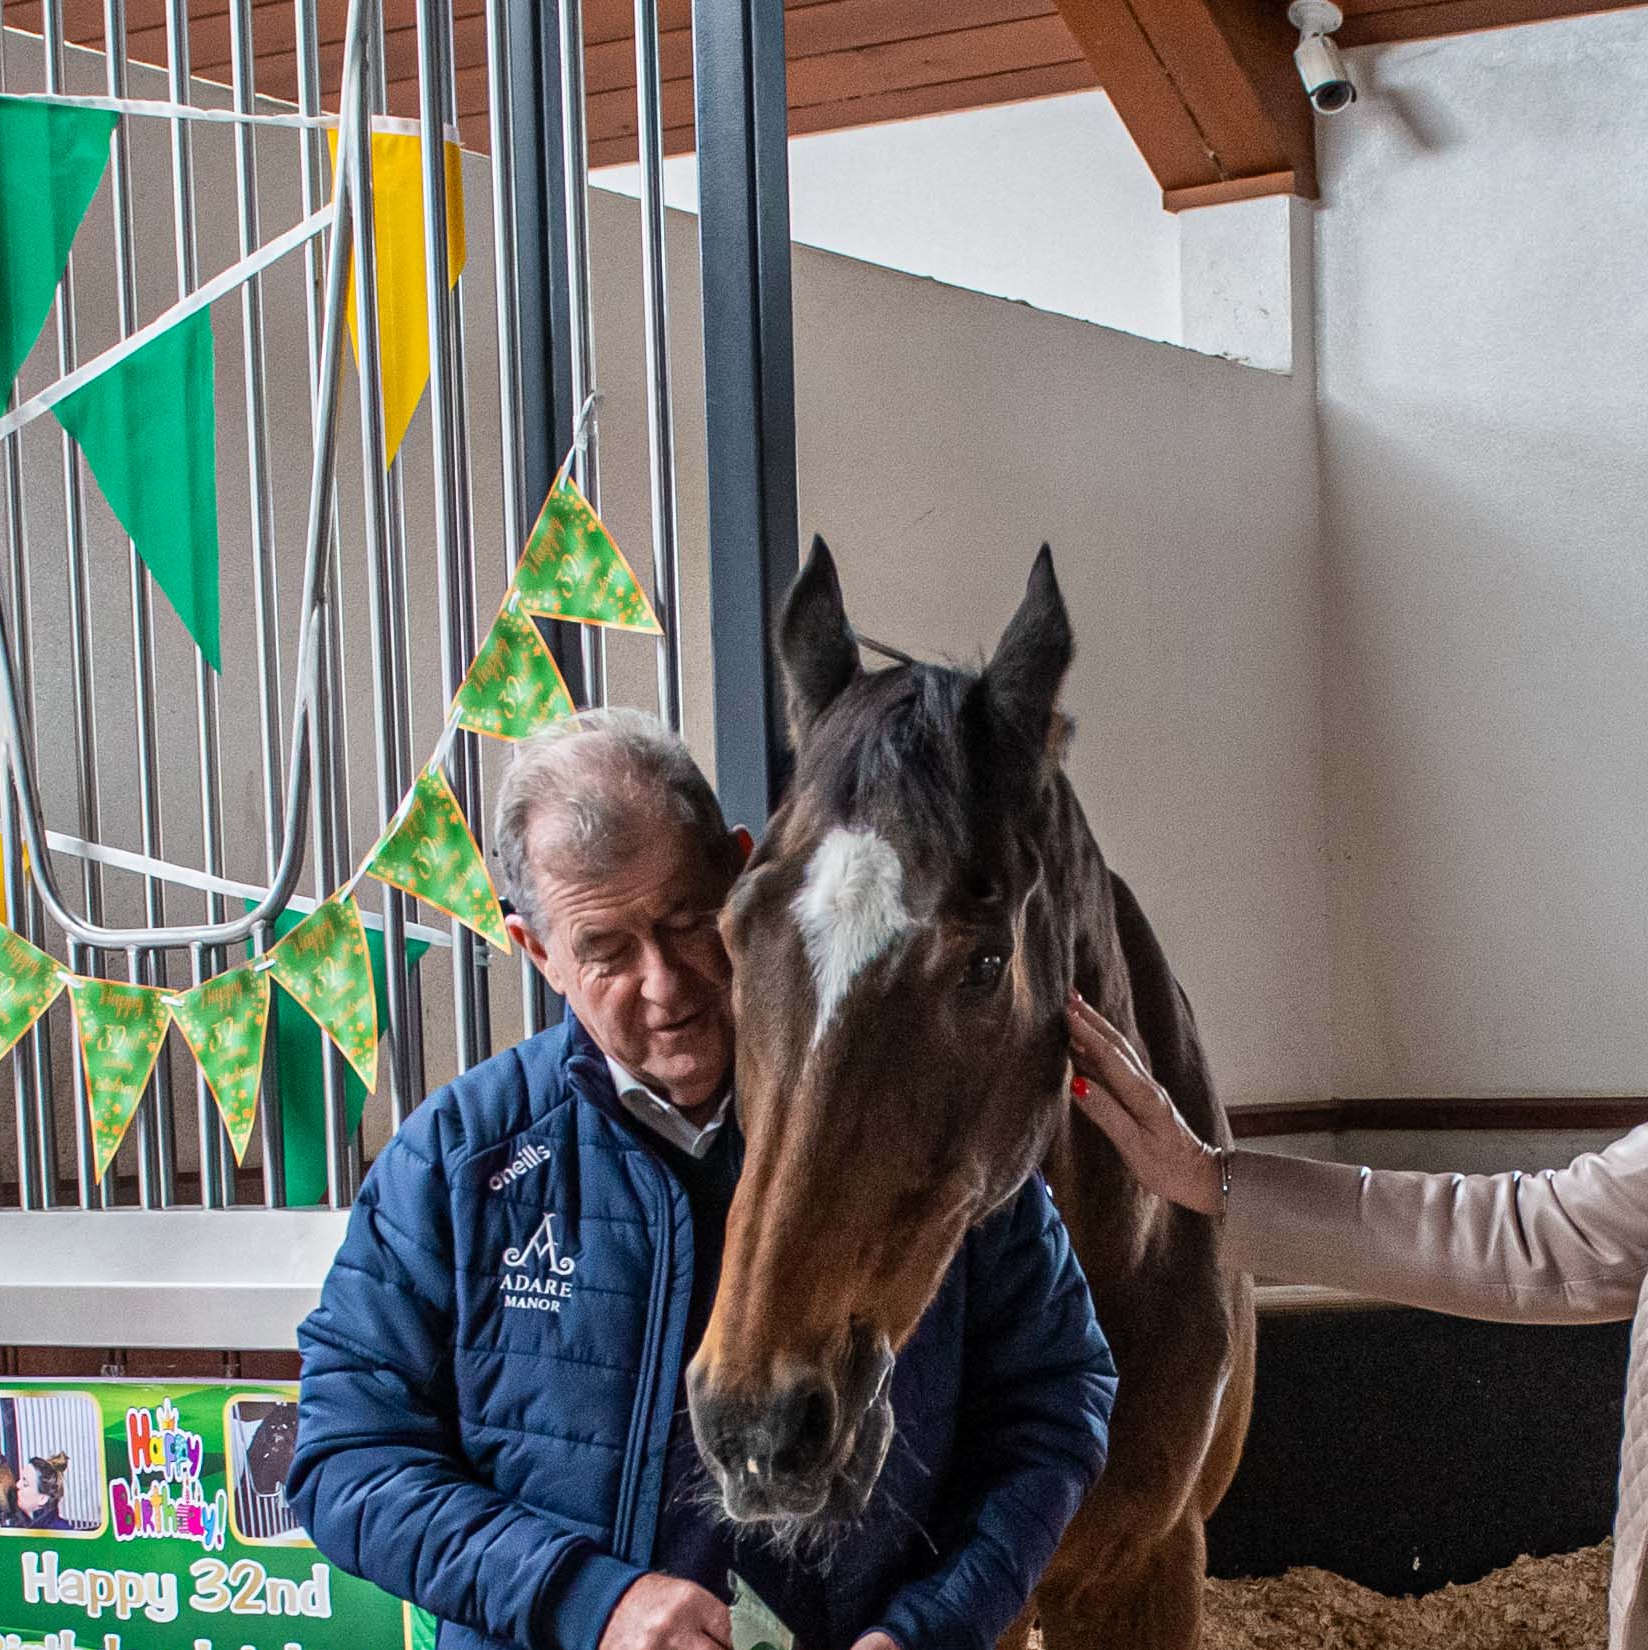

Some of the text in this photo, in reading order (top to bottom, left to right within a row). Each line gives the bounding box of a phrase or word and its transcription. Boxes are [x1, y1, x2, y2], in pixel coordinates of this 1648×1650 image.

[489, 1143, 551, 1191] oneills
[499, 1272, 573, 1298] ADARE
[504, 1295, 561, 1313] MANOR
[127, 1410, 202, 1479] Happy
[20, 1550, 332, 1624] Happy 32nd
